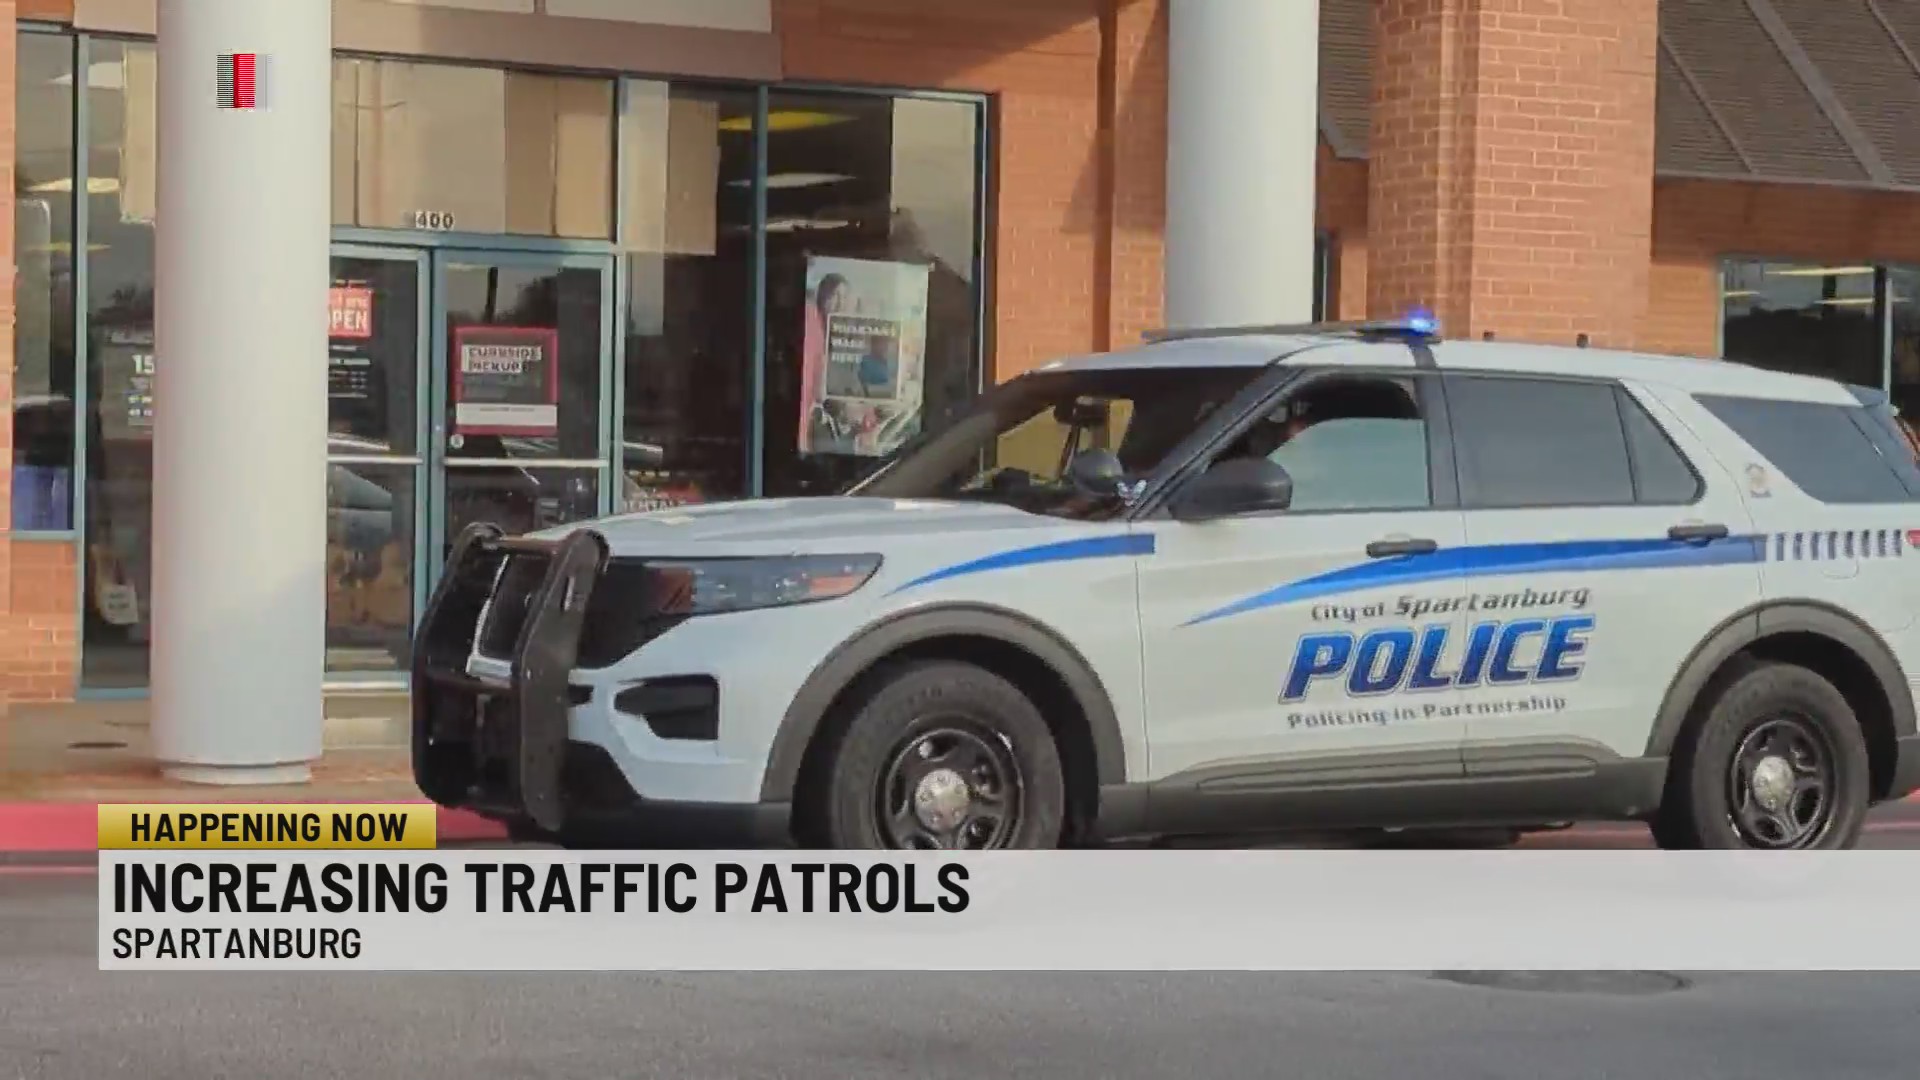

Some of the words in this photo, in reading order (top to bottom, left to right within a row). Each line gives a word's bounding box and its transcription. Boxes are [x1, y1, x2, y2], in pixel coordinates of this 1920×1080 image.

[416, 212, 454, 229] 400
[328, 307, 369, 330] PEN
[1311, 604, 1356, 622] City
[1362, 602, 1385, 617] of
[1395, 586, 1591, 620] Spartanburg
[1278, 613, 1596, 704] POLICE
[1287, 709, 1388, 729] Policing
[1394, 706, 1416, 721] in
[1423, 696, 1567, 718] Partnership
